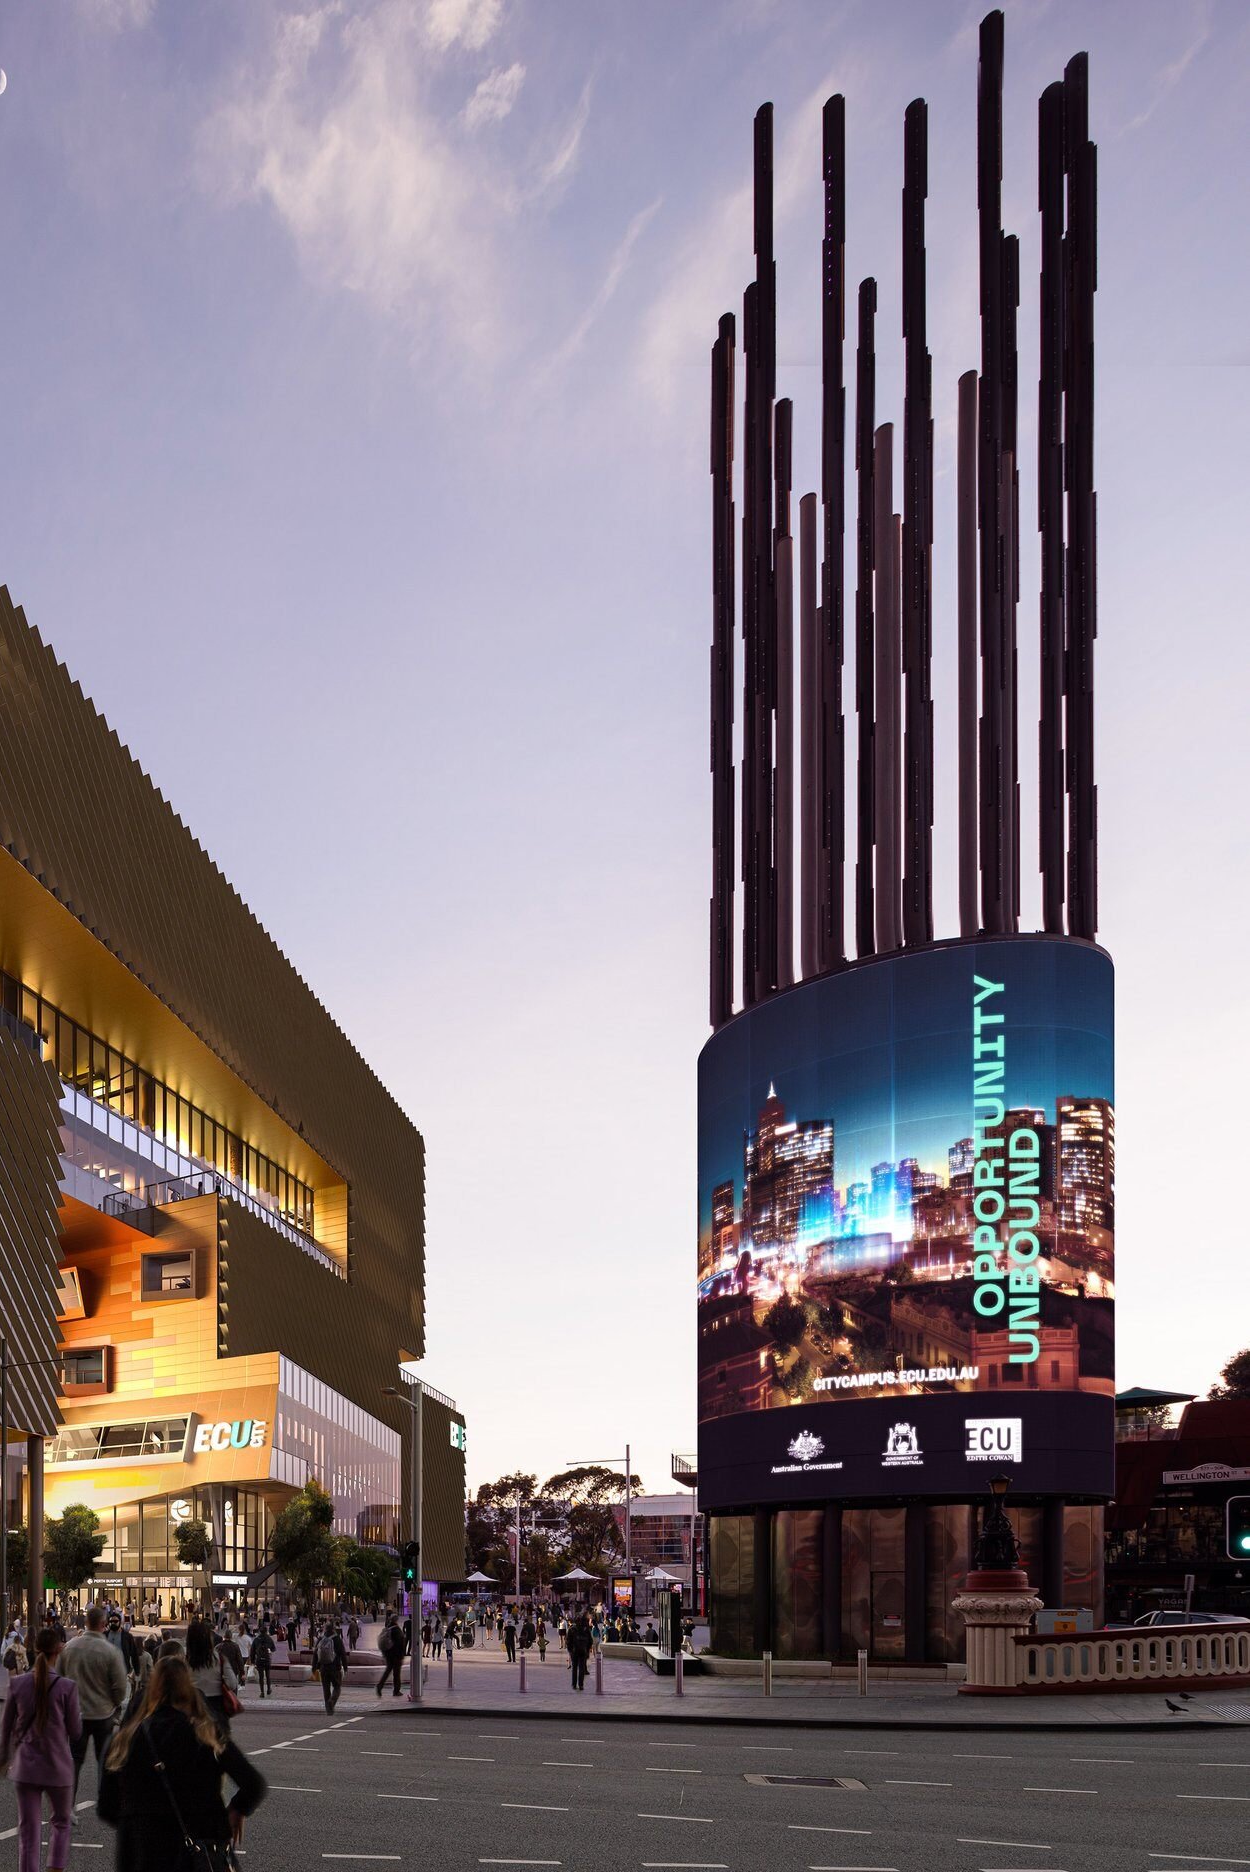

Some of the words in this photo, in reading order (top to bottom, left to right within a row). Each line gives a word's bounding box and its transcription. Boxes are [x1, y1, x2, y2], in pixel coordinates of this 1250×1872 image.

[973, 974, 1006, 1317] OPPORTUNITY
[1008, 1128, 1041, 1364] UNBOUND
[813, 1366, 979, 1391] CITYCAMPUS.ECU.EDU.AU
[193, 1420, 252, 1453] ECU
[250, 1419, 267, 1448] CITY
[965, 1426, 1012, 1451] ECU
[771, 1465, 802, 1474] Australian
[803, 1461, 843, 1471] Government
[1172, 1471, 1230, 1481] WELLINGTON
